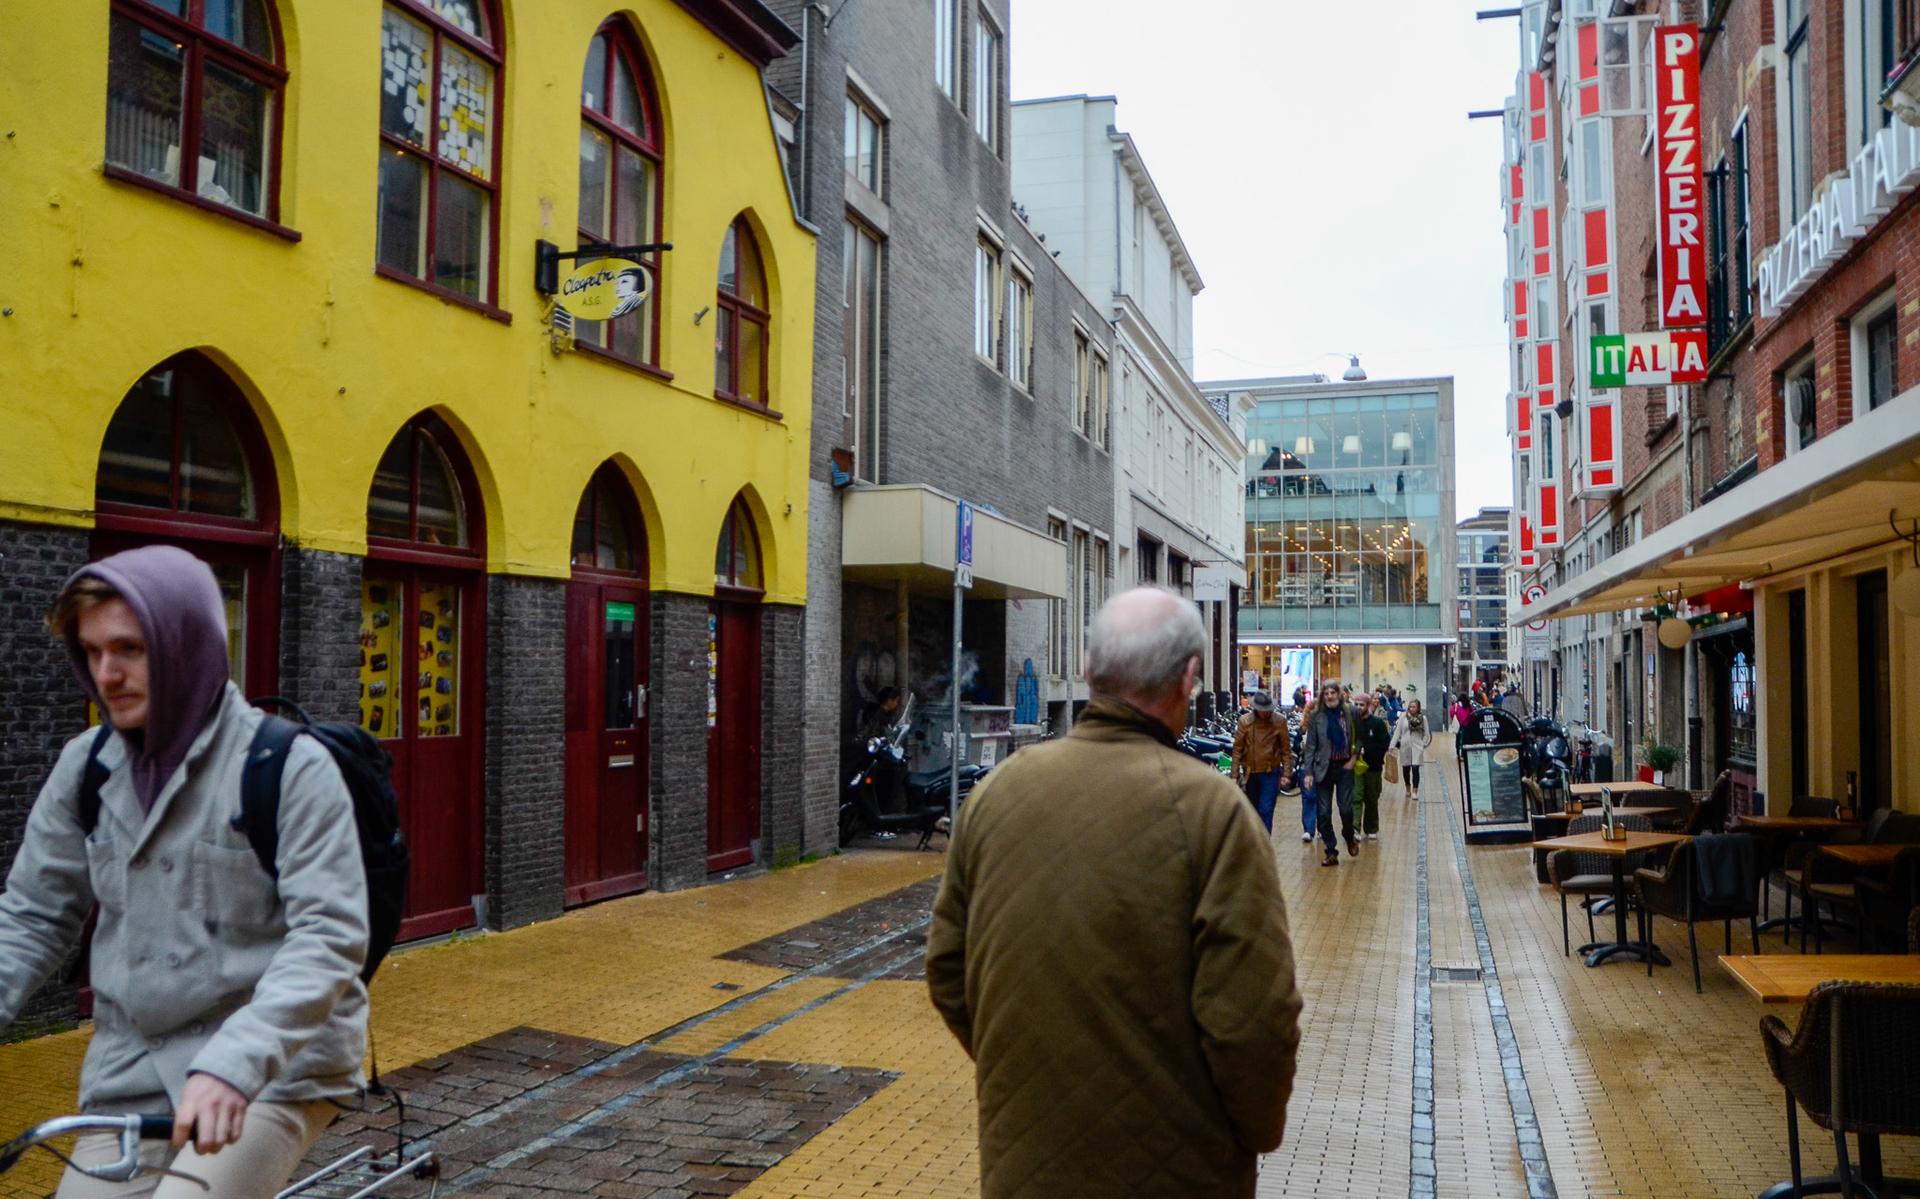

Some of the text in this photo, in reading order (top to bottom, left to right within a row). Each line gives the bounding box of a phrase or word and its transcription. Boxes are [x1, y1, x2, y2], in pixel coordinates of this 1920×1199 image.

[1663, 32, 1702, 318] PIZZERIA
[1758, 111, 1920, 318] PIZZERIA ITALI
[1595, 341, 1705, 376] ITALIA
